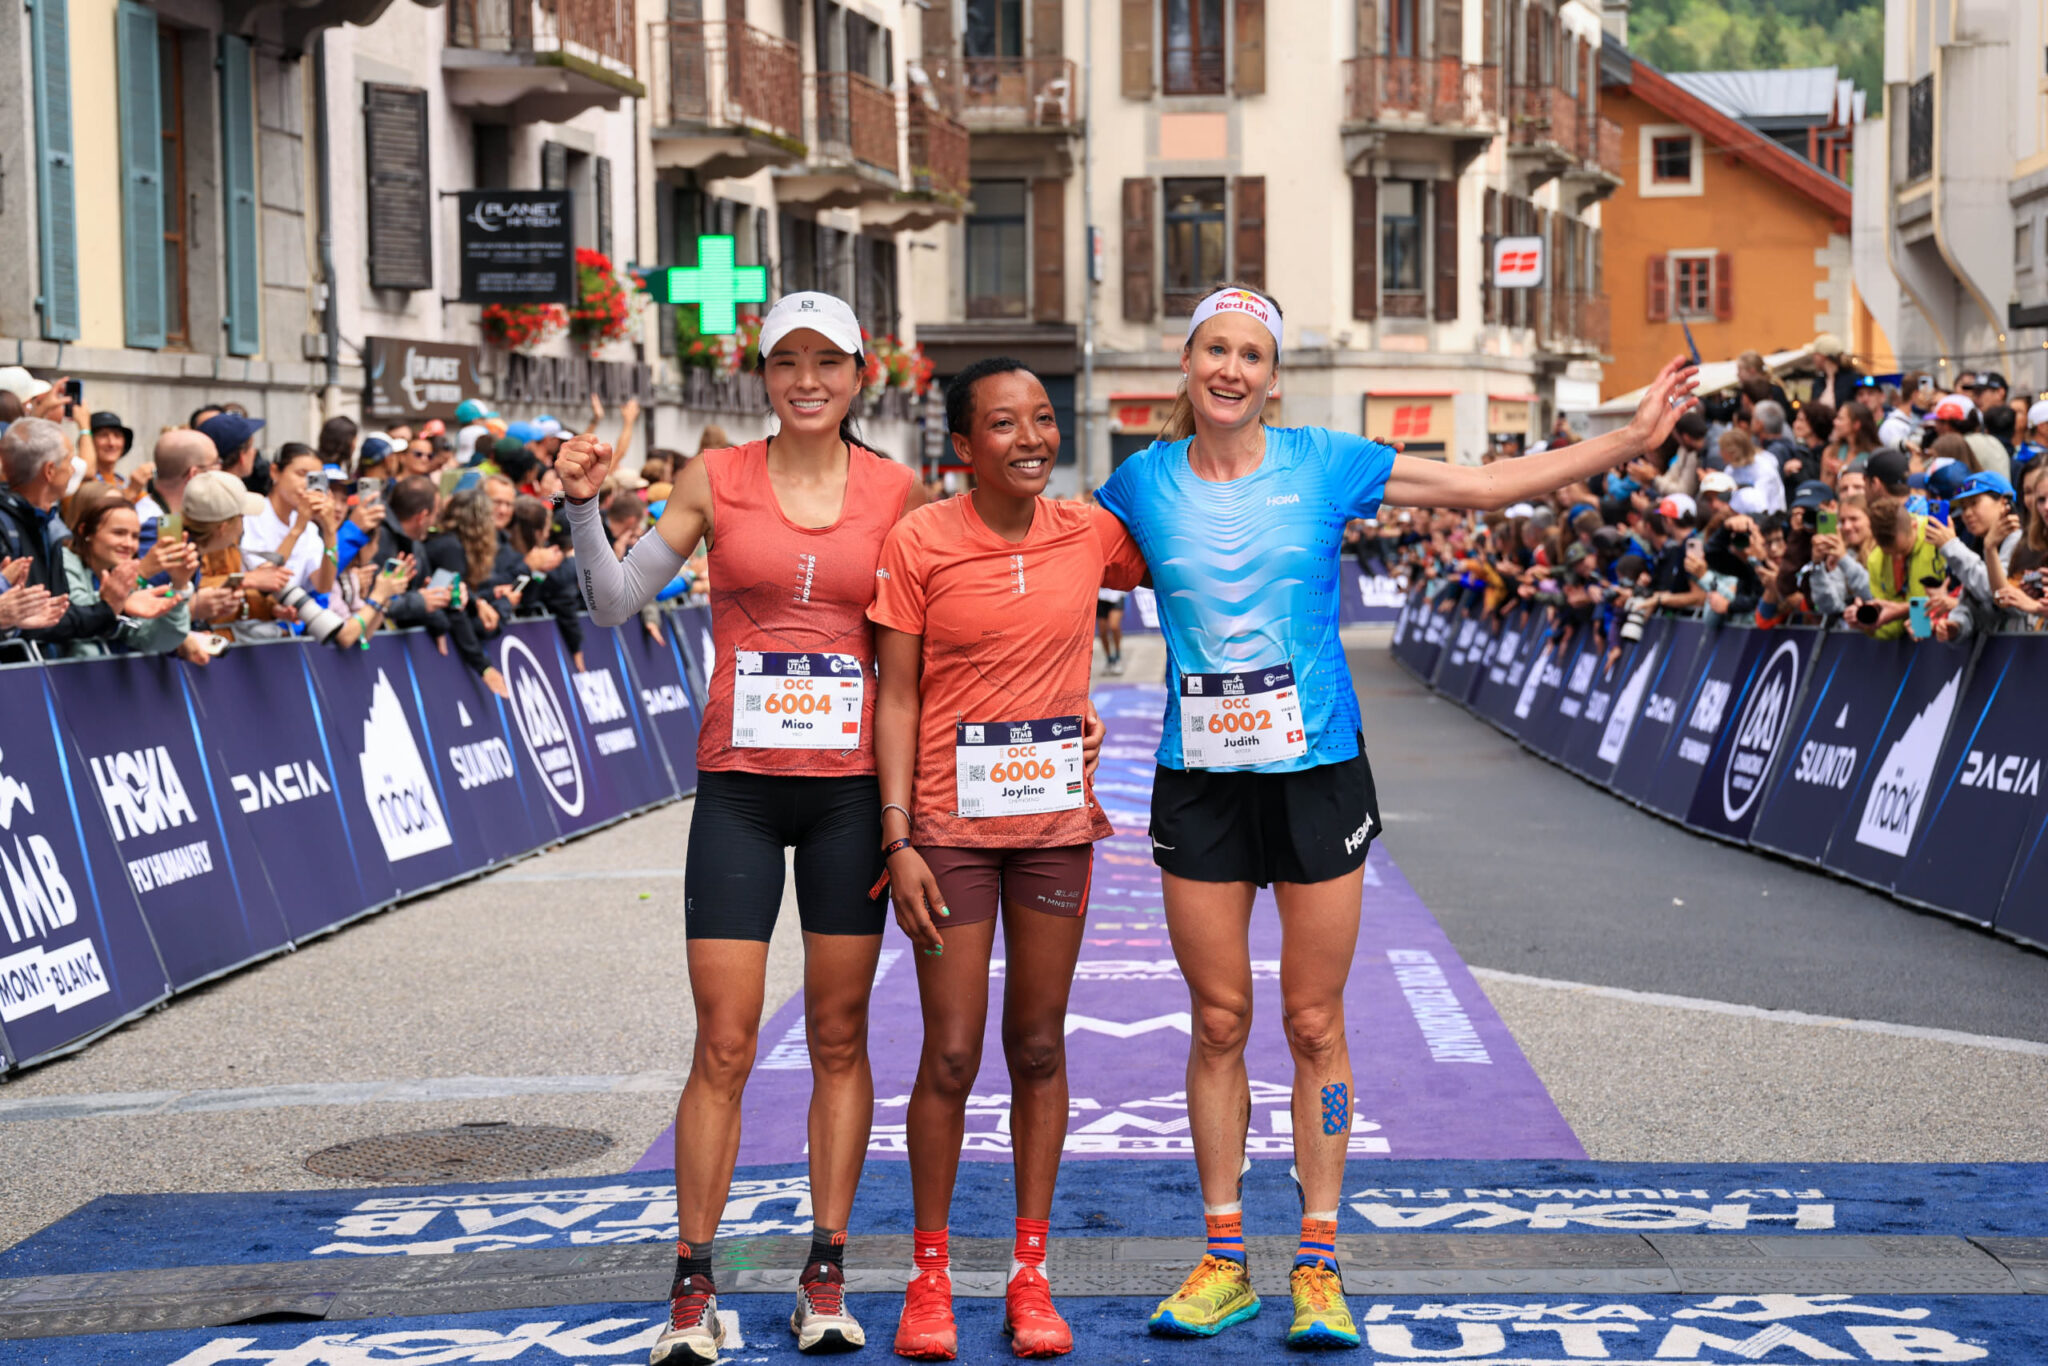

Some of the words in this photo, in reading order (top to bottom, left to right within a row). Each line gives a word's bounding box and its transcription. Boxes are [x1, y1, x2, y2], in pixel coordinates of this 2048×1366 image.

[485, 203, 557, 217] PLANET
[1216, 301, 1243, 311] Red
[1245, 303, 1268, 323] Bull
[1266, 493, 1300, 507] HOKA
[802, 554, 816, 603] SALOMON
[584, 568, 598, 611] SALOMON
[787, 662, 810, 671] UTMB
[783, 679, 813, 690] OCC
[1222, 682, 1245, 691] UTMB
[764, 693, 832, 715] 6004
[847, 703, 851, 711] 1
[1222, 697, 1250, 709] OCC
[1208, 710, 1273, 733] 6002
[1287, 712, 1292, 721] 1
[781, 719, 813, 729] Miao
[1009, 731, 1033, 739] UTMB
[1224, 736, 1260, 747] Judith
[1007, 745, 1037, 758] OCC
[449, 737, 513, 790] SUUNTO
[990, 758, 1055, 783] 6006
[1069, 763, 1073, 772] 1
[1795, 741, 1857, 790] SUUNTO
[1960, 751, 2041, 796] DACIA
[90, 746, 198, 841] HOKA
[231, 760, 331, 813] DACIA
[1001, 785, 1045, 798] Joyline
[1344, 811, 1373, 855] HOKA
[128, 857, 155, 894] FLY
[148, 845, 198, 888] HUMAN
[190, 840, 214, 874] FLY
[1349, 1188, 1451, 1200] FLY
[1462, 1188, 1712, 1200] HUMAN
[1723, 1188, 1825, 1200] FLY
[1350, 1202, 1836, 1230] HOKA
[1363, 1303, 1656, 1322] HOKA
[1365, 1322, 1989, 1363] UTMB
